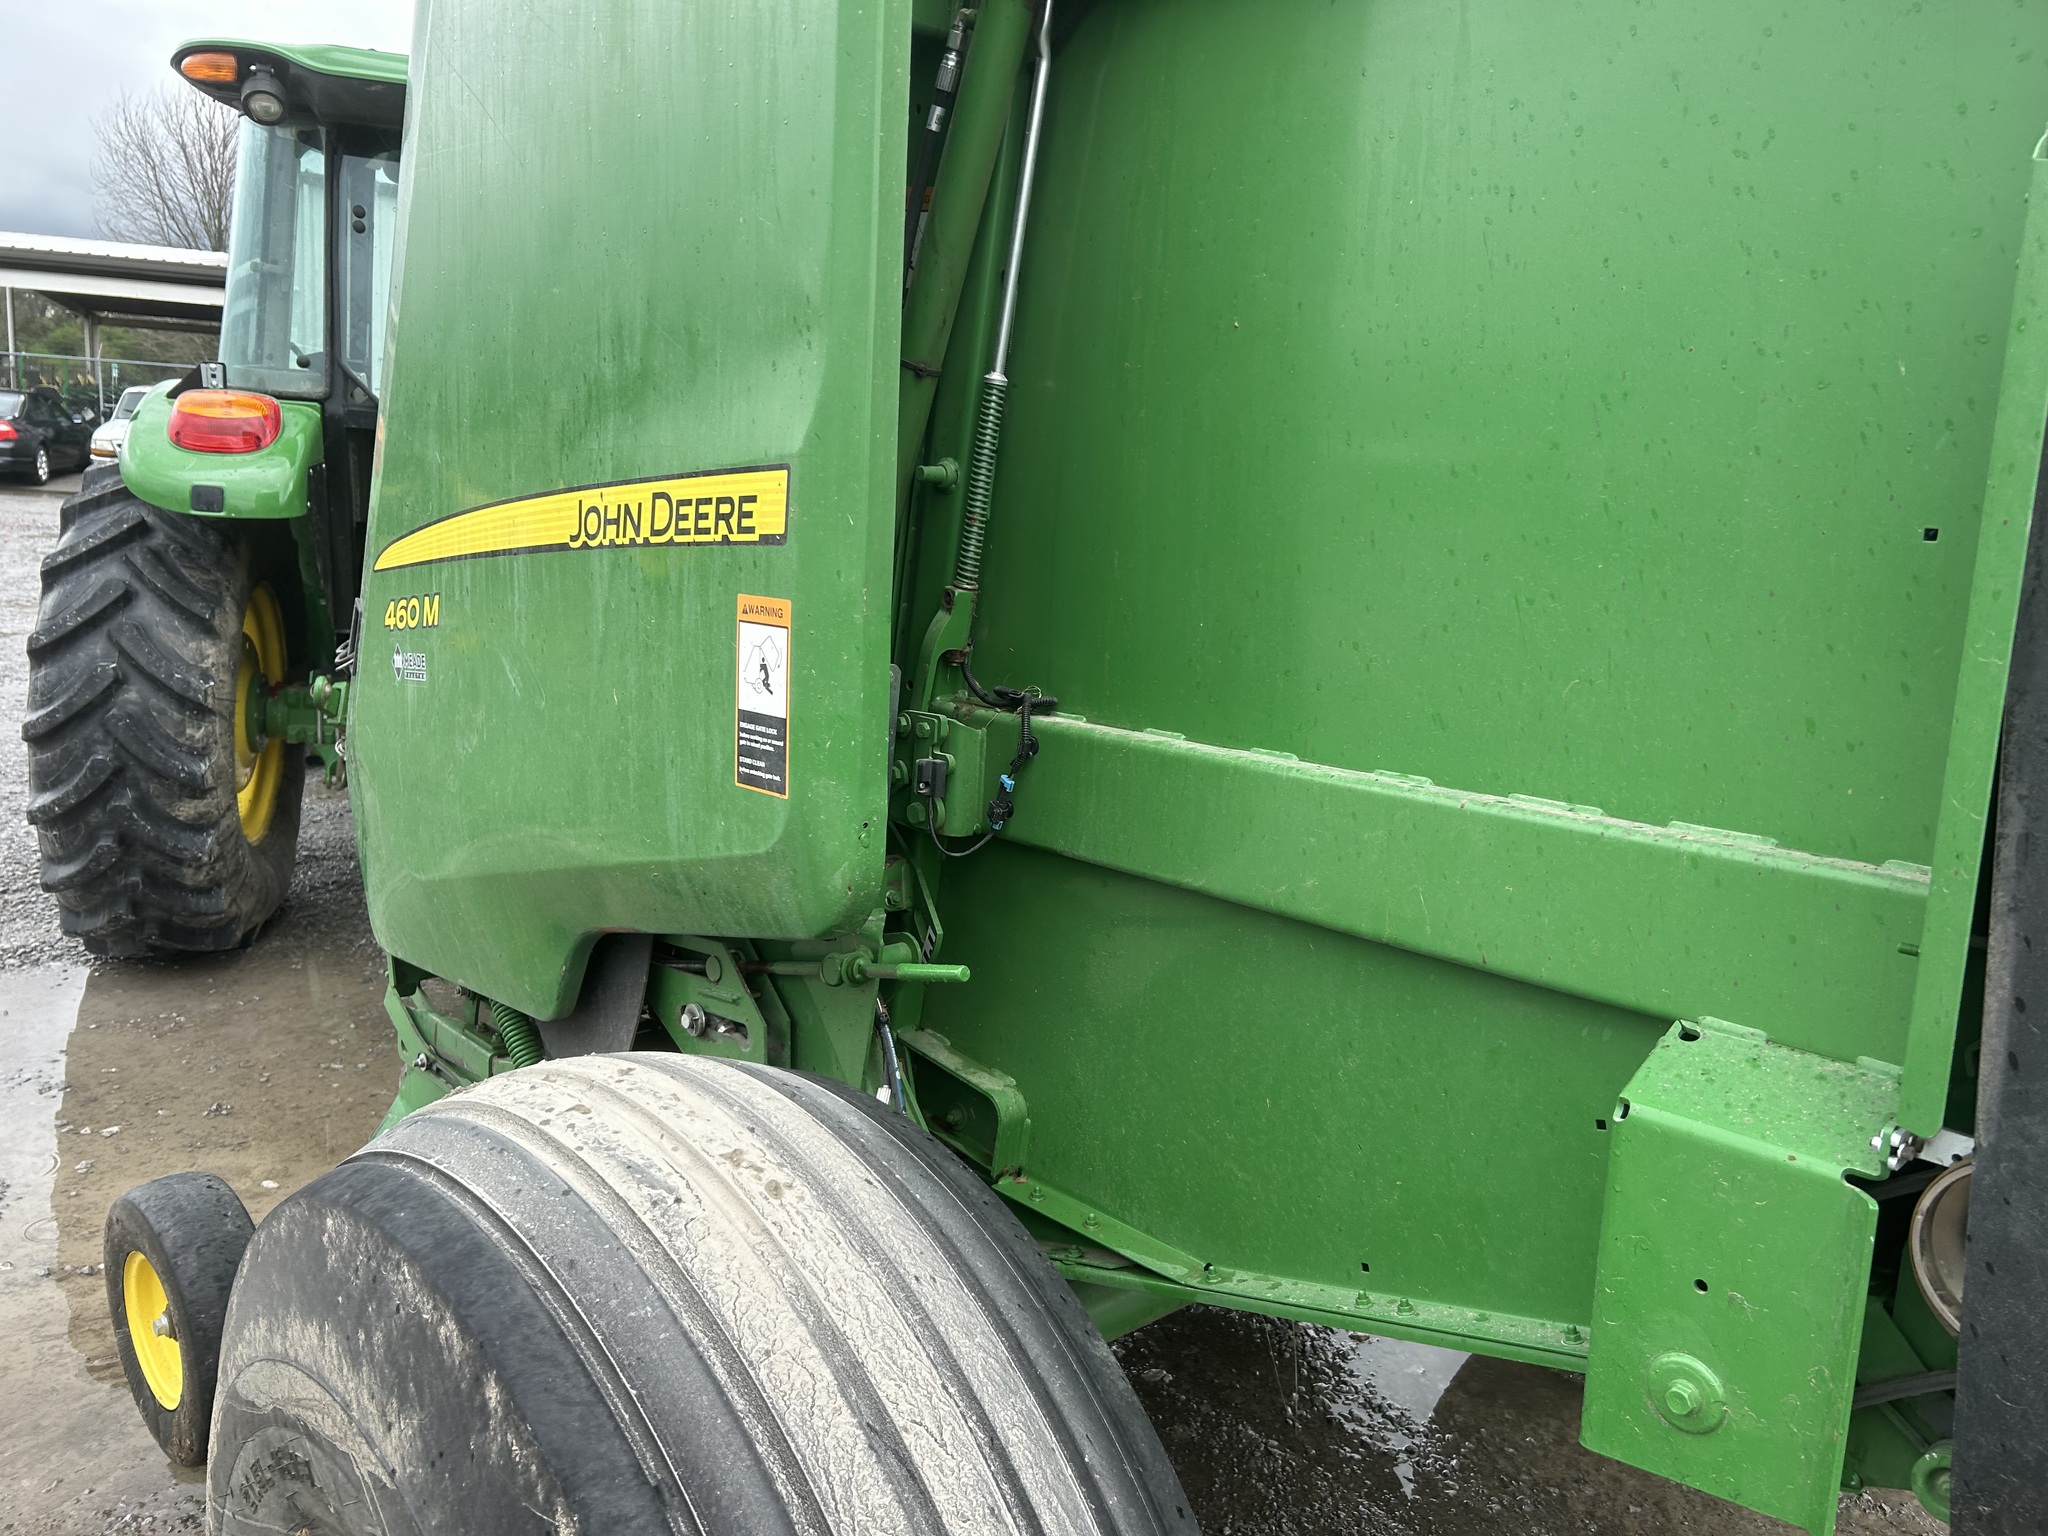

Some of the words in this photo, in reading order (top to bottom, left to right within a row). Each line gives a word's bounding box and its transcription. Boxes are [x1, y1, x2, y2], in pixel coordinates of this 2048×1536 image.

[569, 499, 642, 542] JOHN
[650, 491, 758, 537] DEERE
[384, 597, 420, 632] 460
[422, 591, 440, 628] M
[747, 604, 783, 619] WARNING
[403, 652, 426, 669] MEADE
